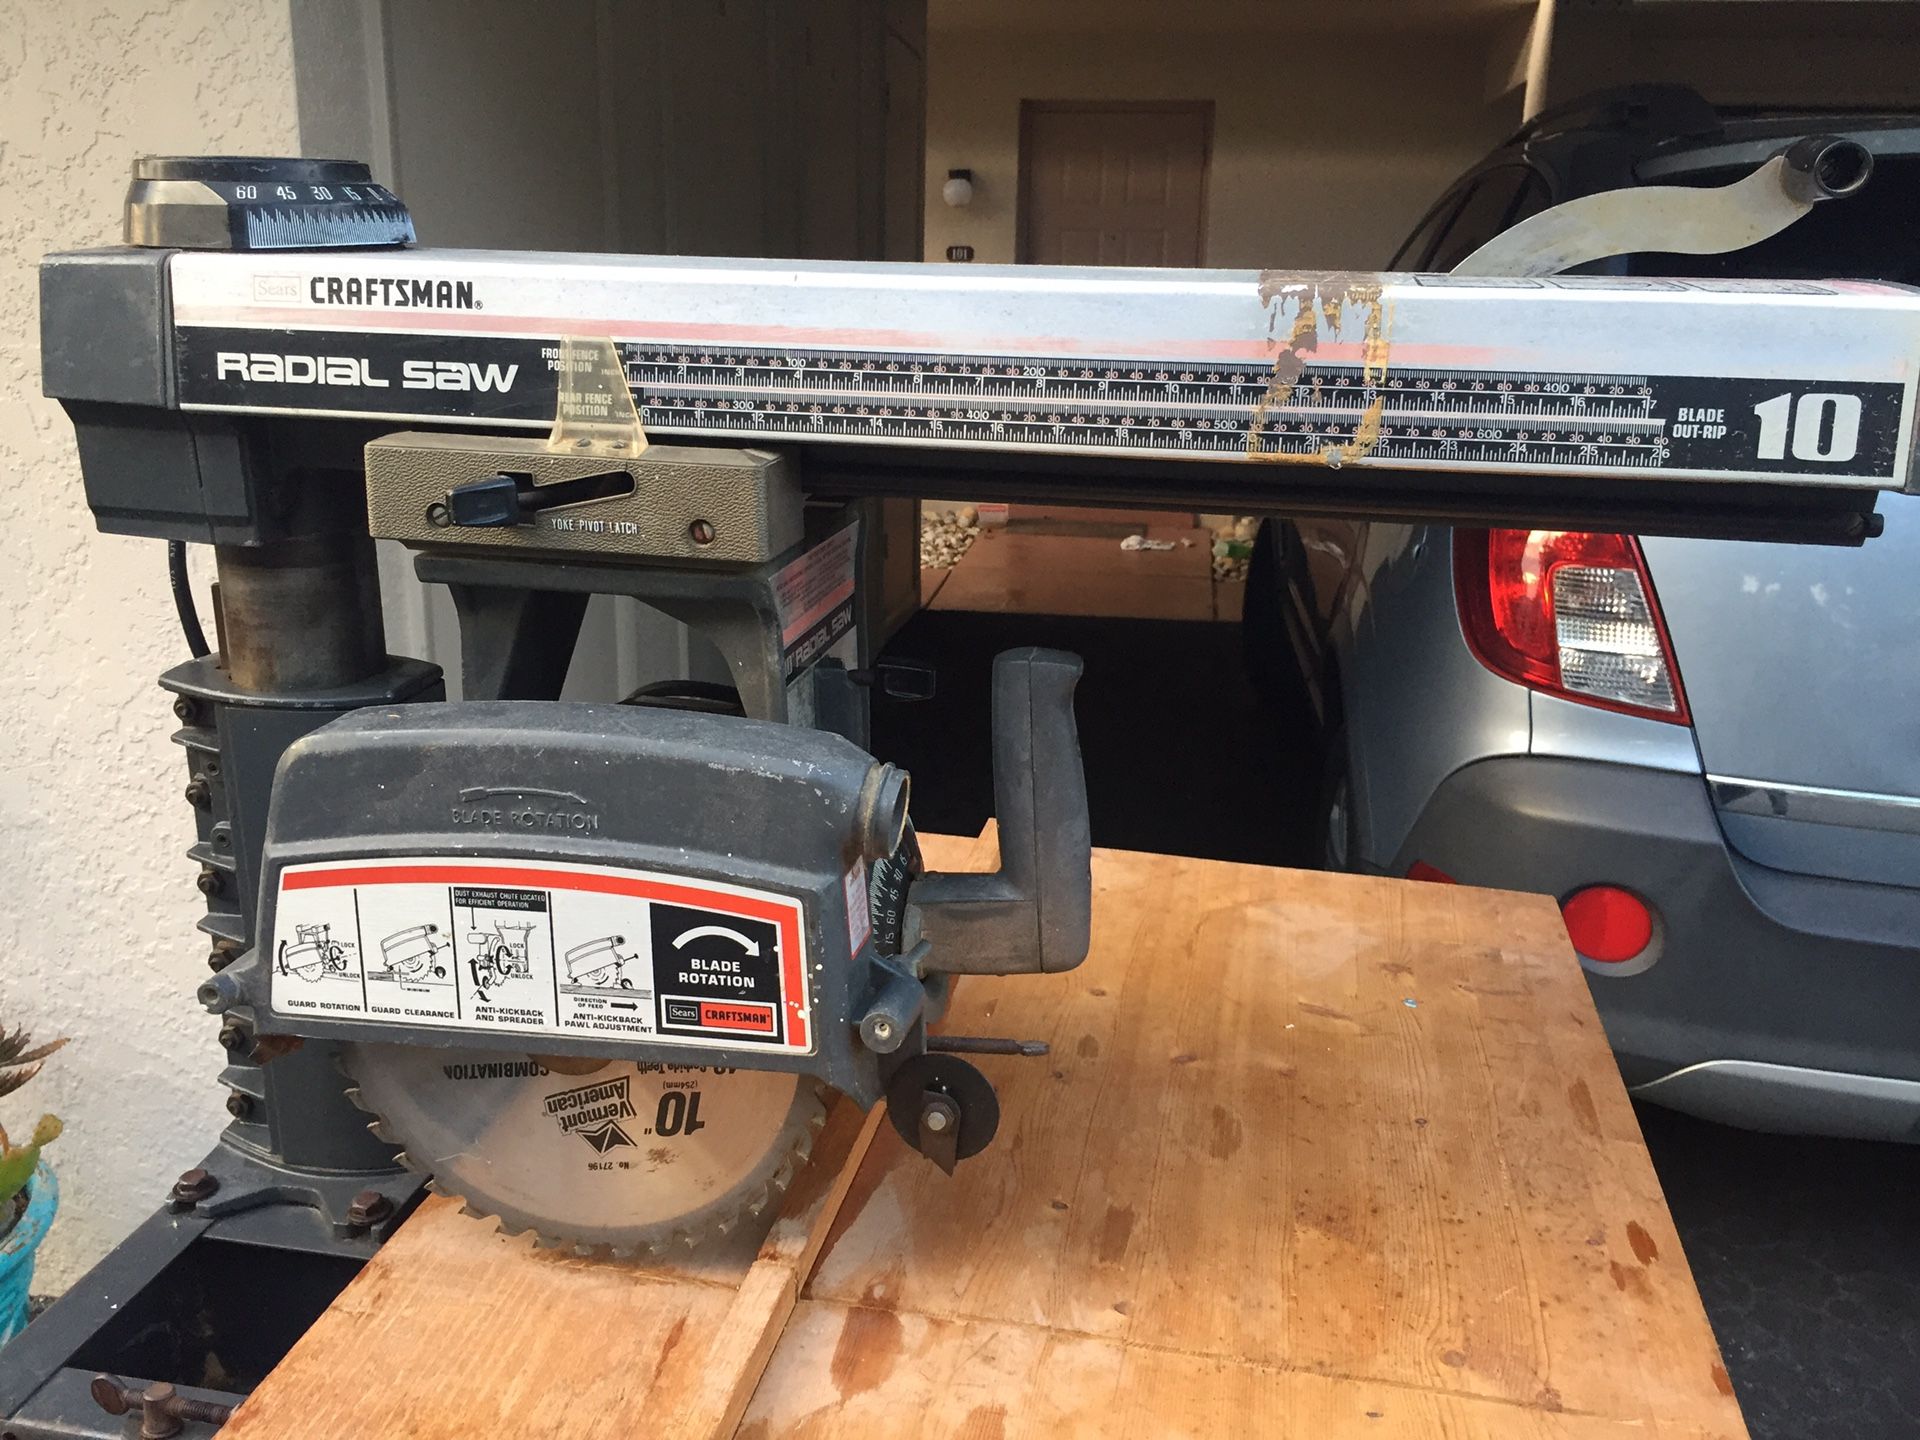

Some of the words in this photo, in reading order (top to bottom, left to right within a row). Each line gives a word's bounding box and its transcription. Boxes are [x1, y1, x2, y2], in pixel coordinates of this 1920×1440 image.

[236, 186, 256, 199] 60
[277, 186, 297, 200] 45
[311, 186, 333, 200] 30
[342, 186, 361, 200] 15
[258, 280, 297, 297] Sears
[786, 359, 806, 368] 100
[1024, 367, 1045, 376] 200
[1105, 371, 1118, 379] 30
[1155, 372, 1168, 380] 50
[1206, 374, 1219, 382] 70
[1336, 379, 1349, 387] 20
[1389, 380, 1402, 389] 40
[1416, 381, 1429, 390] 50
[1497, 384, 1511, 392] 80
[1525, 384, 1539, 393] 90
[1544, 384, 1568, 394] 400
[1583, 386, 1595, 395] 10
[1609, 386, 1623, 395] 20
[1637, 387, 1652, 396] 30
[678, 366, 684, 374] 2
[975, 377, 980, 386] 7
[1036, 380, 1043, 388] 8
[1098, 382, 1105, 390] 9
[1166, 384, 1179, 393] 10
[1230, 386, 1241, 394] 11
[1431, 393, 1445, 401] 14
[1500, 395, 1515, 404] 15
[1570, 398, 1585, 406] 16
[1642, 400, 1657, 409] 17
[585, 393, 613, 404] FENCE
[563, 404, 608, 416] POSITION
[1678, 408, 1725, 423] BLADE
[734, 402, 754, 411] 300
[967, 411, 988, 421] 400
[1096, 417, 1109, 425] 50
[1146, 419, 1159, 427] 70
[1197, 421, 1210, 429] 90
[1214, 420, 1237, 430] 500
[1273, 424, 1287, 432] 20
[1299, 425, 1313, 433] 30
[1378, 428, 1392, 436] 60
[1432, 430, 1446, 438] 80
[1478, 430, 1502, 440] 600
[1516, 432, 1528, 441] 10
[1569, 434, 1583, 443] 30
[1626, 436, 1640, 445] 50
[1654, 437, 1668, 446] 60
[1754, 392, 1862, 462] 10
[638, 408, 649, 417] 10
[810, 416, 823, 424] 13
[930, 421, 943, 430] 15
[991, 423, 1004, 432] 16
[1115, 429, 1128, 437] 18
[1178, 431, 1192, 439] 19
[1306, 436, 1320, 445] 21
[1440, 441, 1457, 450] 23
[1510, 444, 1527, 453] 24
[1580, 446, 1598, 455] 25
[1652, 449, 1670, 458] 26
[1673, 424, 1727, 439] OUT-RIP
[552, 519, 574, 530] YOKE
[580, 520, 604, 532] PIVOT
[609, 522, 637, 534] LATCH
[452, 809, 501, 824] BLADE
[511, 811, 598, 829] ROTATION
[890, 888, 899, 902] 45
[886, 910, 896, 924] 60
[691, 959, 740, 973] BLADE
[679, 972, 755, 988] ROTATION
[288, 1000, 316, 1008] GUARD
[320, 1002, 360, 1011] ROTATION
[371, 1006, 400, 1014] GUARD
[404, 1009, 454, 1018] CLEARANCE
[475, 1006, 544, 1017] ANTI-KICKBACK
[672, 1007, 695, 1018] Sears
[498, 1016, 544, 1025] SPREADER
[573, 1013, 643, 1024] ANTI-KICKBACK
[706, 1010, 767, 1024] CRAFTSMAN
[565, 1020, 590, 1029] PAWL
[593, 1022, 652, 1034] ADJUSTMENT
[663, 1080, 698, 1089] (254mm)
[547, 1081, 624, 1113] American
[560, 1100, 631, 1132] Vermont
[644, 1092, 705, 1136] 10"
[588, 1162, 613, 1170] 27196
